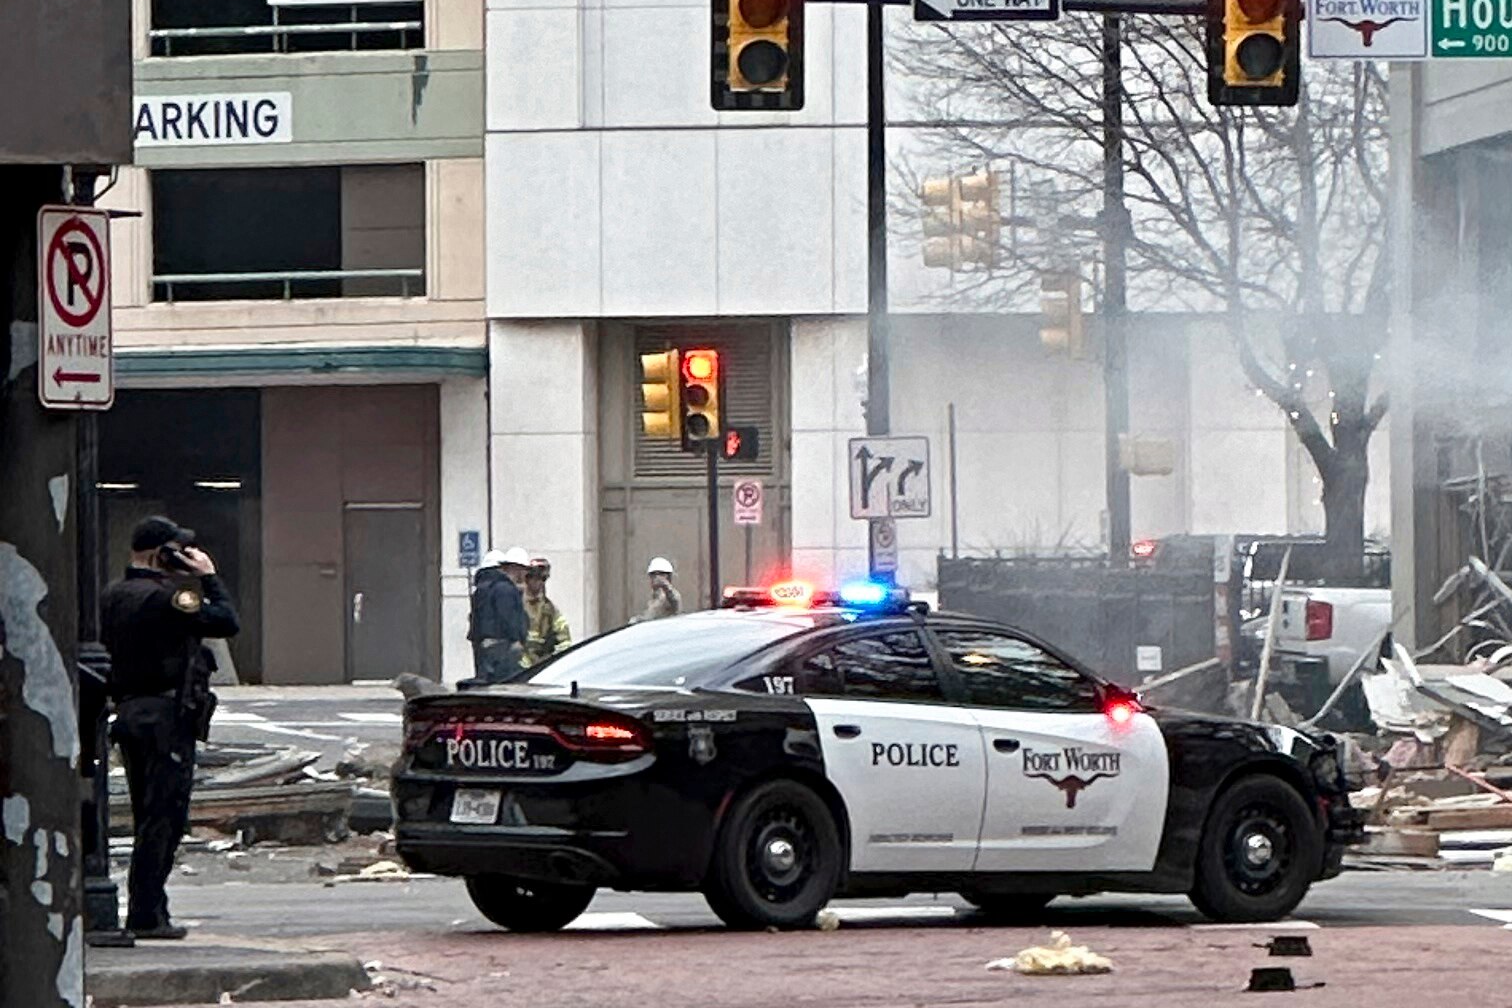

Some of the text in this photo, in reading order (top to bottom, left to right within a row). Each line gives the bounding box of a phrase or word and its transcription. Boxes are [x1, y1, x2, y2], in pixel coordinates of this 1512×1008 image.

[1472, 34, 1509, 52] 900
[134, 99, 279, 141] ARKING
[47, 333, 108, 359] ANYTIME
[892, 498, 928, 513] ONLY
[446, 738, 530, 769] POLICE
[871, 743, 960, 767] POLICE
[1022, 748, 1121, 772] FORT WORTH
